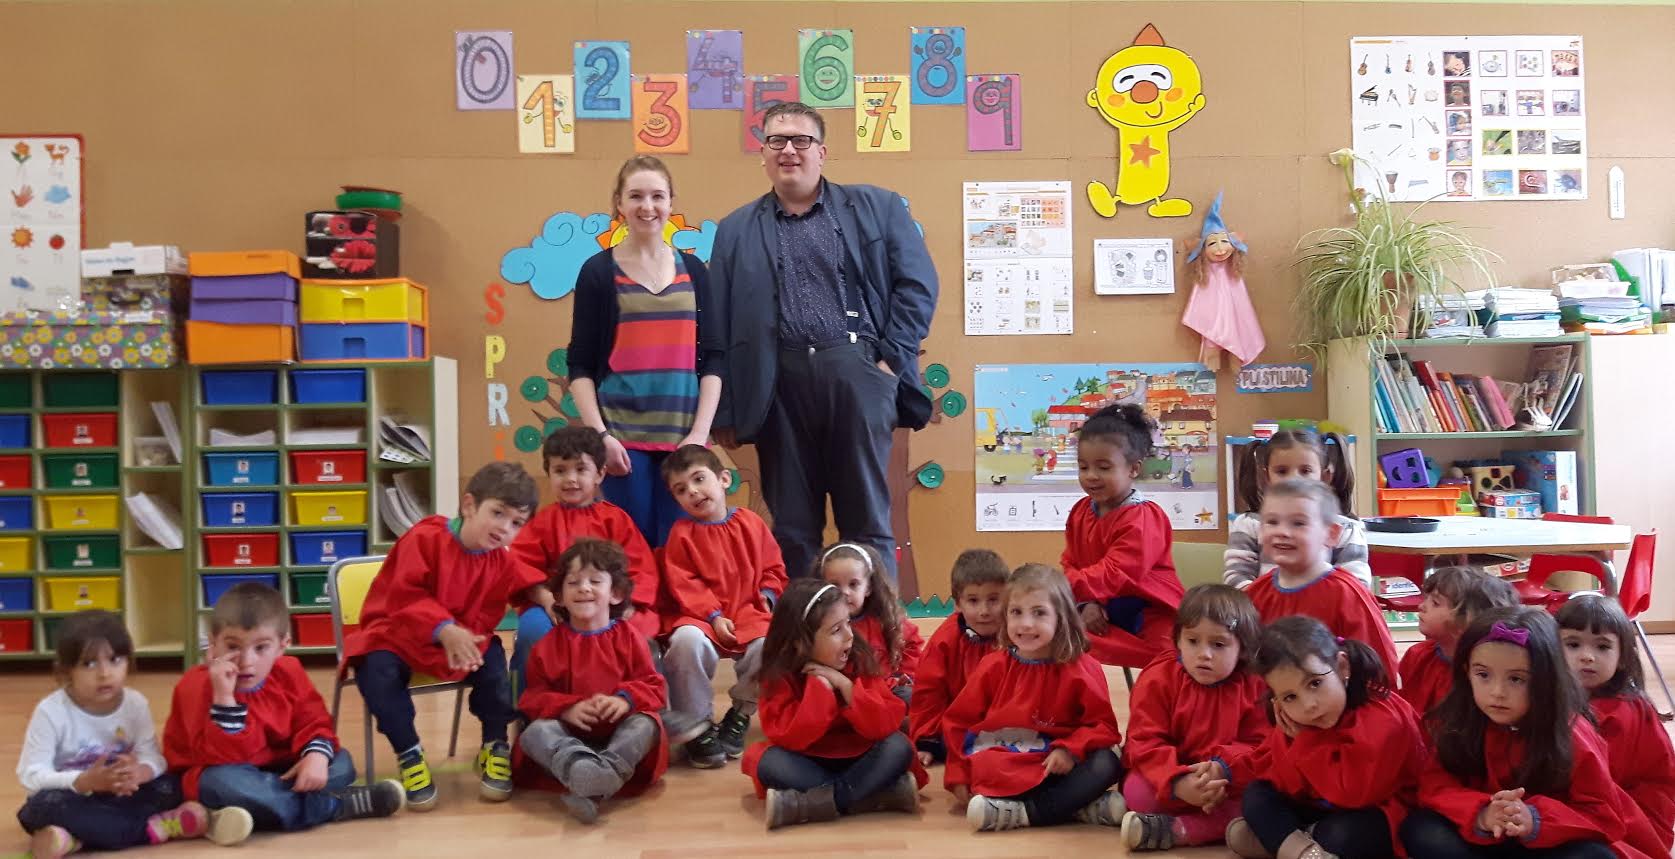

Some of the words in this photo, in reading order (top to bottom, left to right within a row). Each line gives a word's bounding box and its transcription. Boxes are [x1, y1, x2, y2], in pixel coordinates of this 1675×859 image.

[461, 36, 510, 104] 0
[583, 46, 621, 111] 2
[691, 37, 738, 103] 4
[803, 34, 849, 101] 6
[917, 33, 958, 97] 8
[523, 81, 556, 148] 1
[637, 82, 682, 147] 3
[863, 81, 902, 147] 7
[973, 77, 1013, 146] 9
